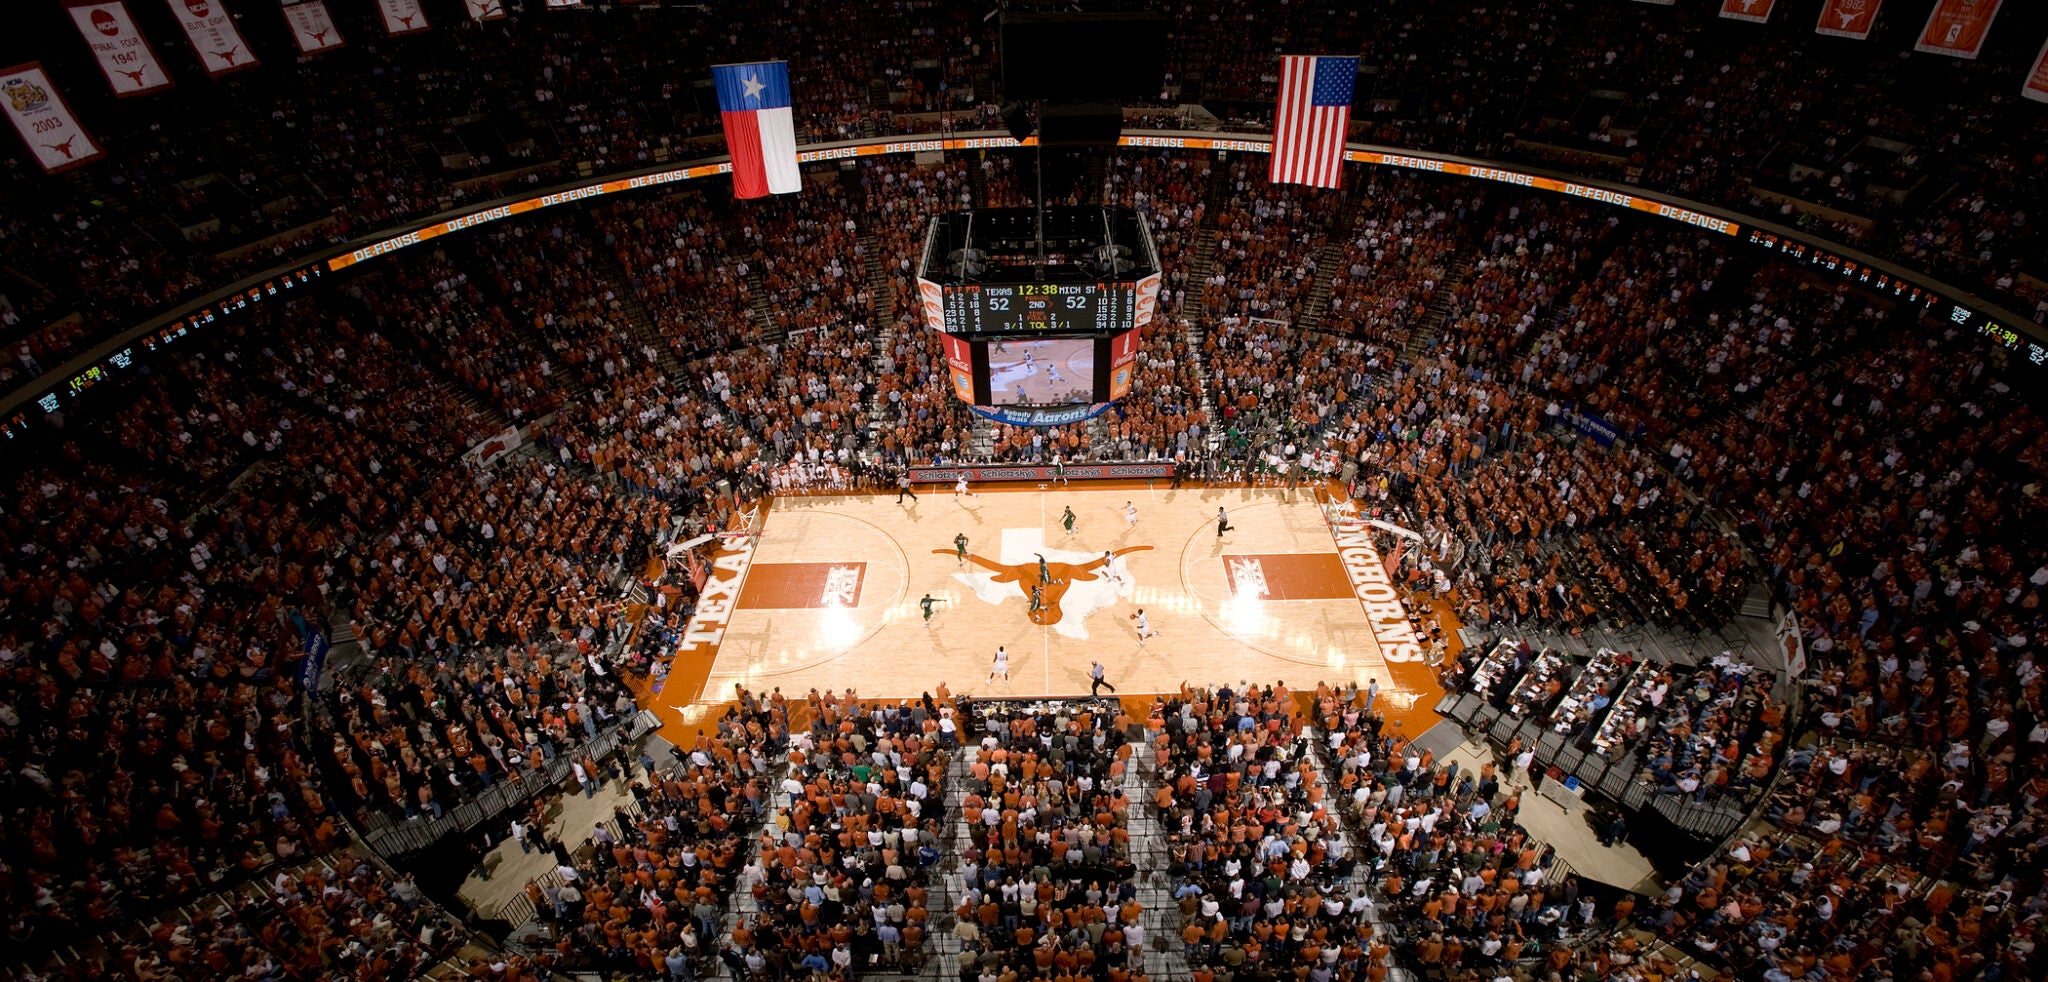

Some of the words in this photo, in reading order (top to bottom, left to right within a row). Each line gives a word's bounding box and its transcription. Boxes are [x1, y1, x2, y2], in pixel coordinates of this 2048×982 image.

[187, 20, 206, 30] ELITE
[92, 42, 117, 51] FINAL
[120, 37, 141, 46] FOUR
[112, 52, 138, 65] 1947
[32, 116, 62, 134] 2003
[986, 288, 1012, 296] TEXAS
[1019, 285, 1058, 295] 12:38
[1059, 286, 1081, 294] MICH
[989, 298, 1010, 310] 52
[1066, 296, 1086, 309] 52
[1951, 313, 1966, 324] 52
[1985, 321, 2018, 343] 12:38
[117, 357, 132, 368] 52
[2029, 352, 2045, 365] 52
[69, 366, 100, 389] 12:38
[44, 400, 60, 413] 52
[1032, 408, 1086, 423] Aaron's
[680, 536, 752, 650] TEXAS
